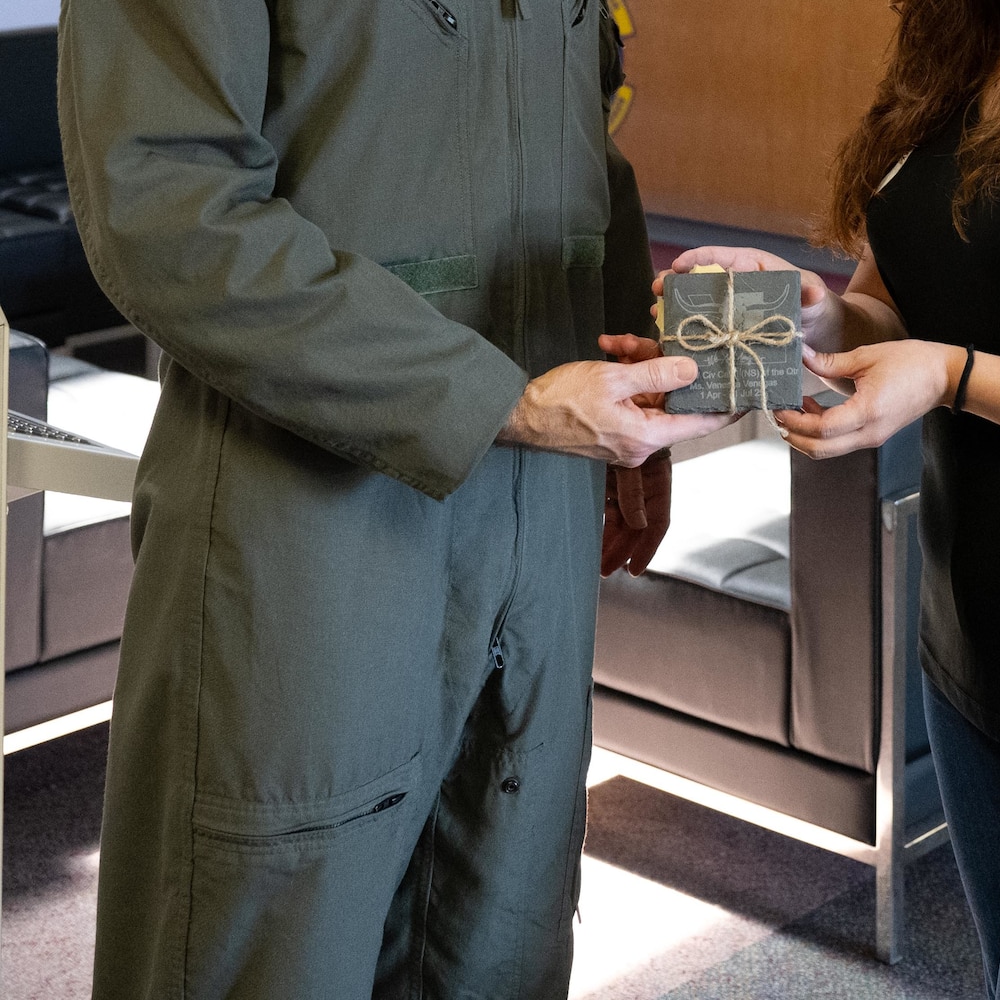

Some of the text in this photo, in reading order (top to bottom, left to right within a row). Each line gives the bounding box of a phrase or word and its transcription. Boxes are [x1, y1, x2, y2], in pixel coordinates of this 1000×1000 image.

[771, 367, 784, 376] the
[744, 379, 778, 389] Vengas
[706, 390, 722, 401] Apr
